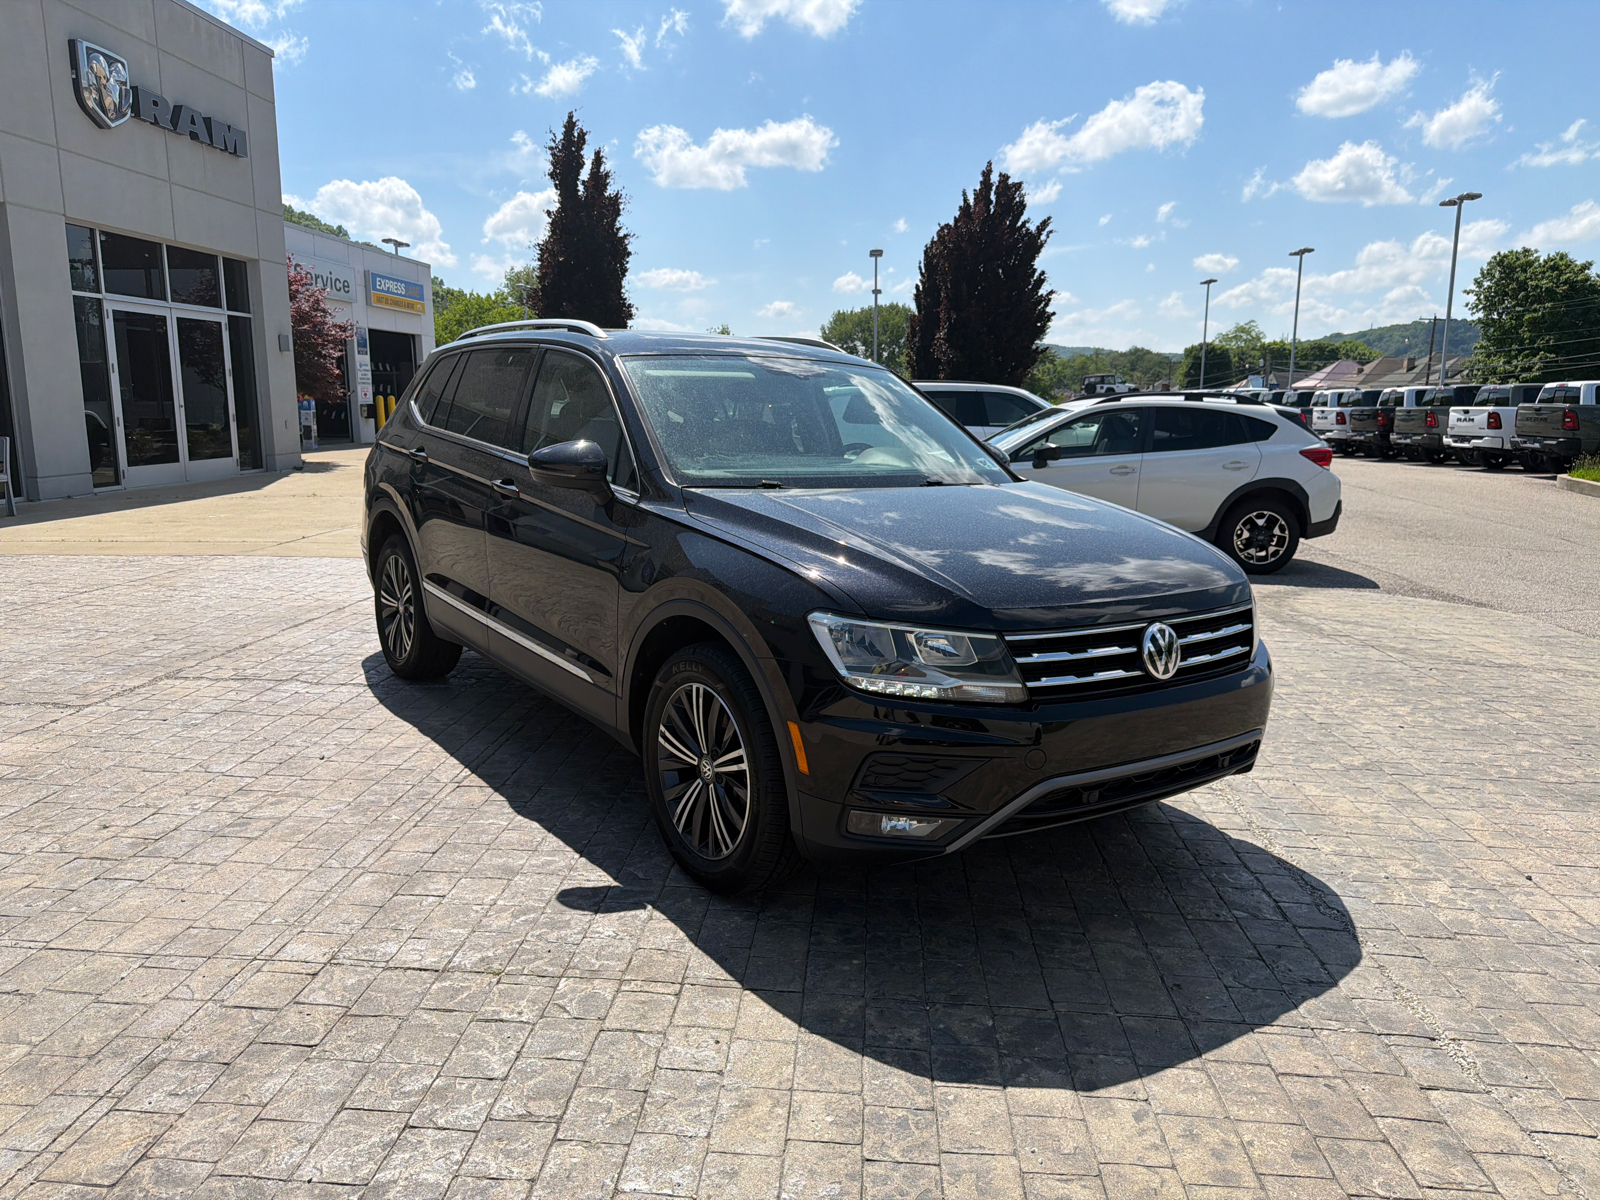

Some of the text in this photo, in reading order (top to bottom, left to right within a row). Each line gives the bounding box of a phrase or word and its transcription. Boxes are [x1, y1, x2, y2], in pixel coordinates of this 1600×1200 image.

[131, 85, 248, 158] RAM
[376, 277, 406, 295] EXPRESS
[672, 660, 705, 675] KELLY
